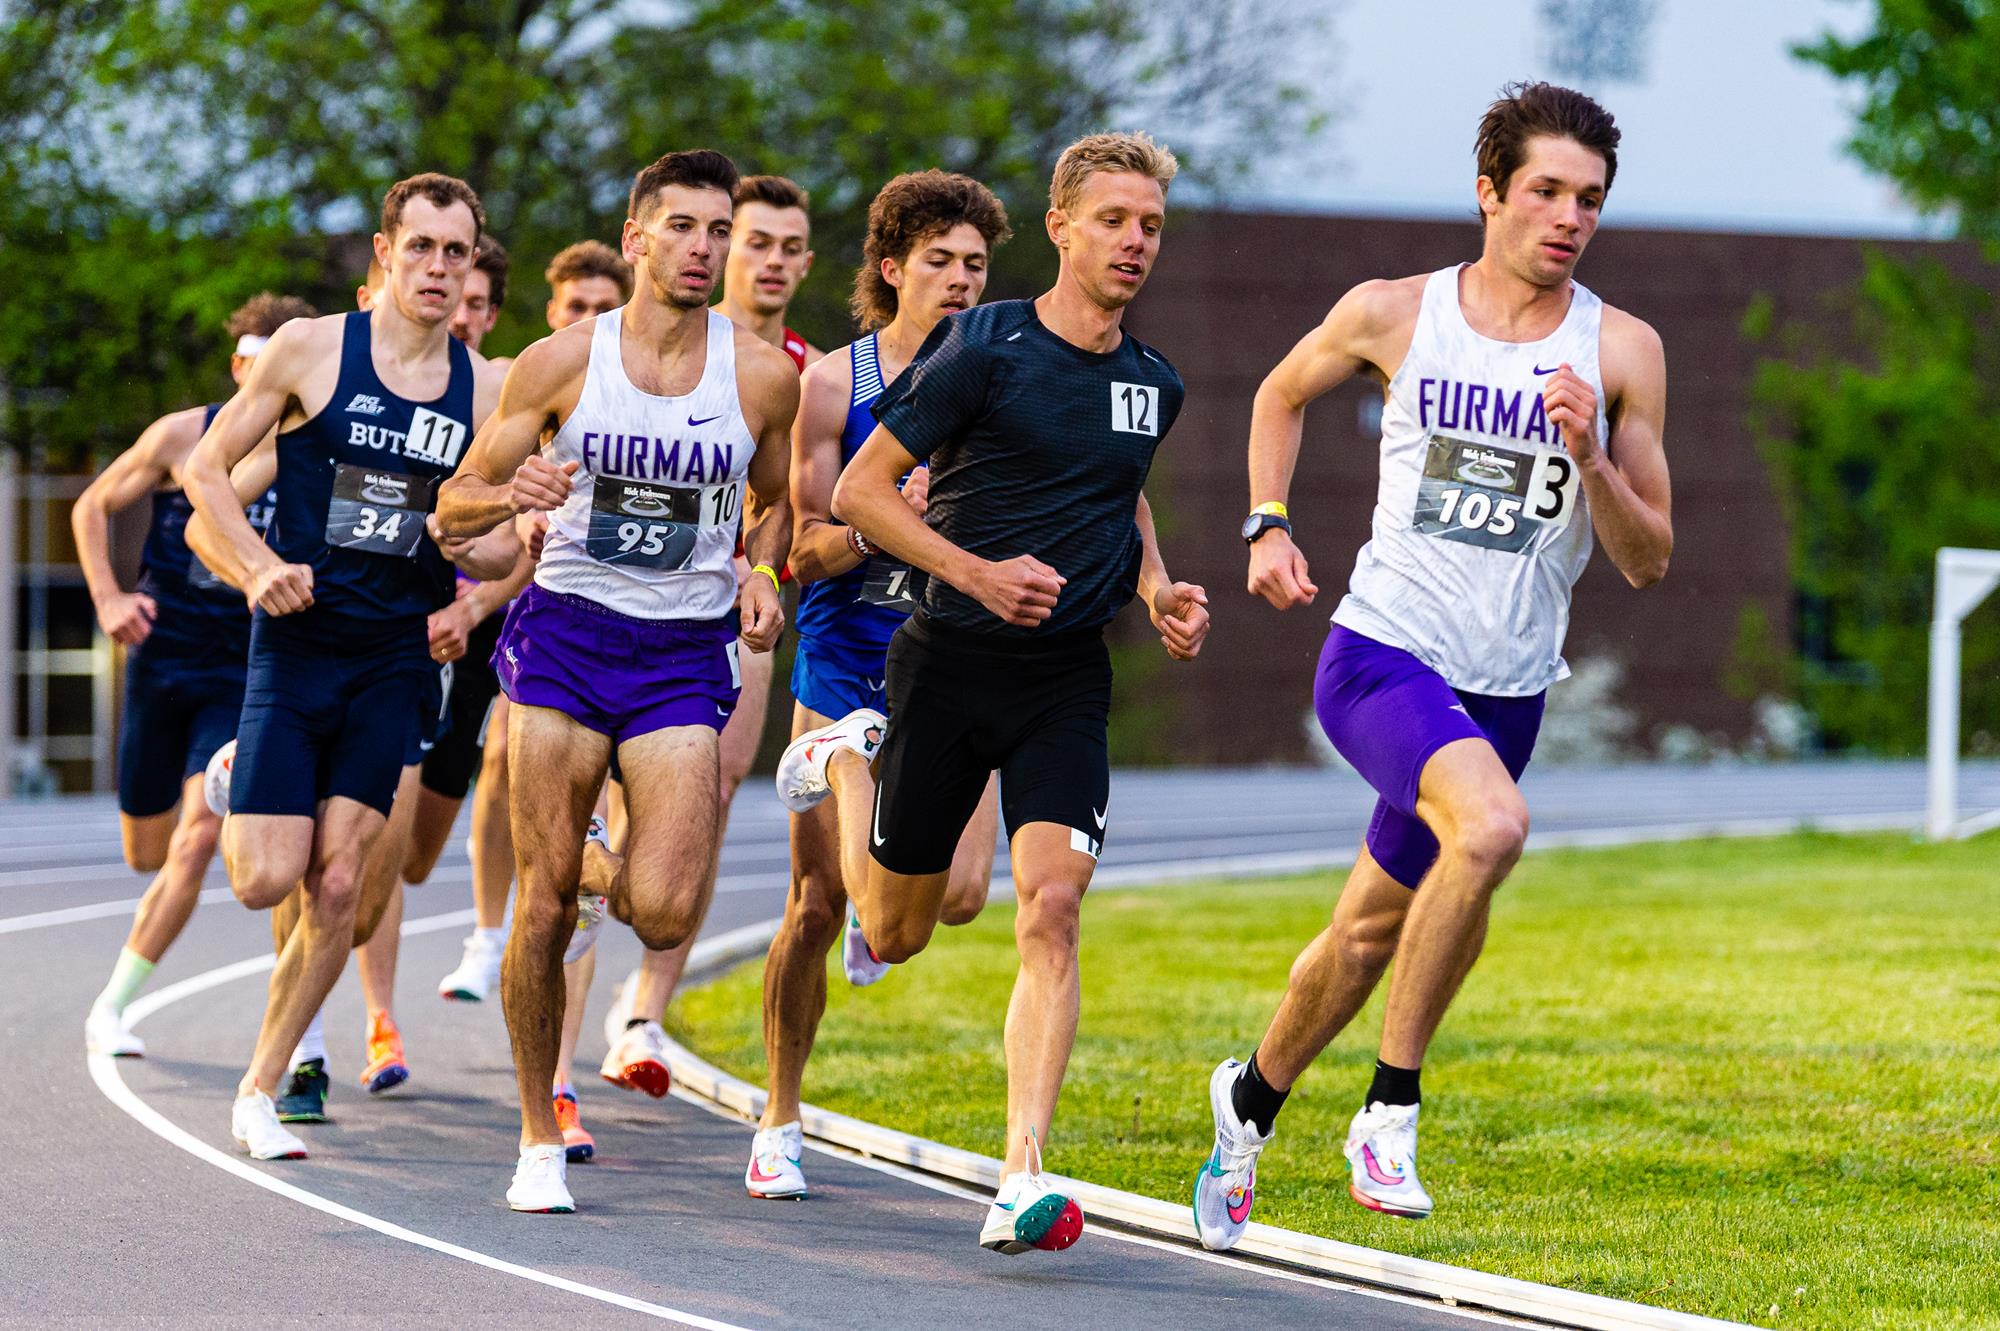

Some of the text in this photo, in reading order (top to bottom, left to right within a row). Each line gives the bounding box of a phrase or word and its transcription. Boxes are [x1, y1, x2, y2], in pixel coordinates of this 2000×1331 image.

[347, 401, 386, 415] EAST
[1120, 386, 1151, 432] 12
[348, 421, 451, 468] BUT
[423, 415, 455, 460] 11
[583, 432, 733, 483] FURMAN
[712, 483, 737, 526] 10
[1534, 457, 1571, 519] 3
[352, 507, 402, 543] 34
[1439, 489, 1522, 535] 105
[617, 522, 668, 555] 95
